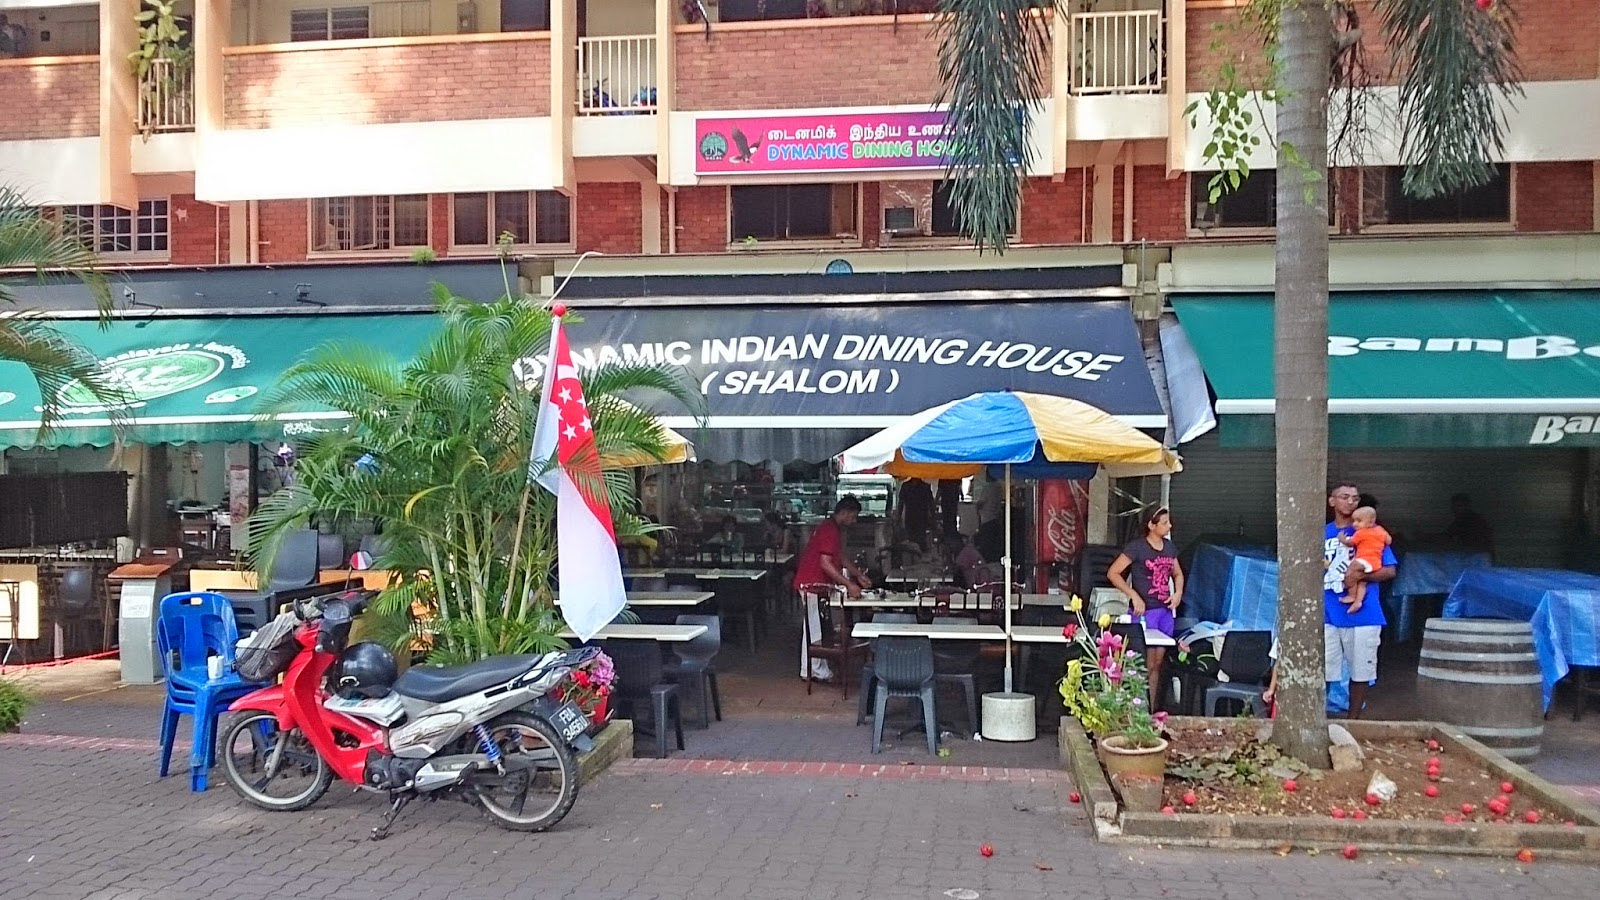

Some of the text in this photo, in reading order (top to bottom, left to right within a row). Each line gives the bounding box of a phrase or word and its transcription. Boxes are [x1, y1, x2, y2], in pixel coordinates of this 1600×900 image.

[849, 122, 901, 142] இந்திய
[767, 143, 849, 161] DYNAMIC
[852, 141, 913, 159] DINING
[701, 334, 830, 364] INDIAN
[833, 335, 968, 364] DINING
[967, 341, 1125, 381] HOUSE
[1529, 416, 1600, 444] Ba
[559, 707, 577, 725] FBA
[563, 715, 588, 741] 3456U
